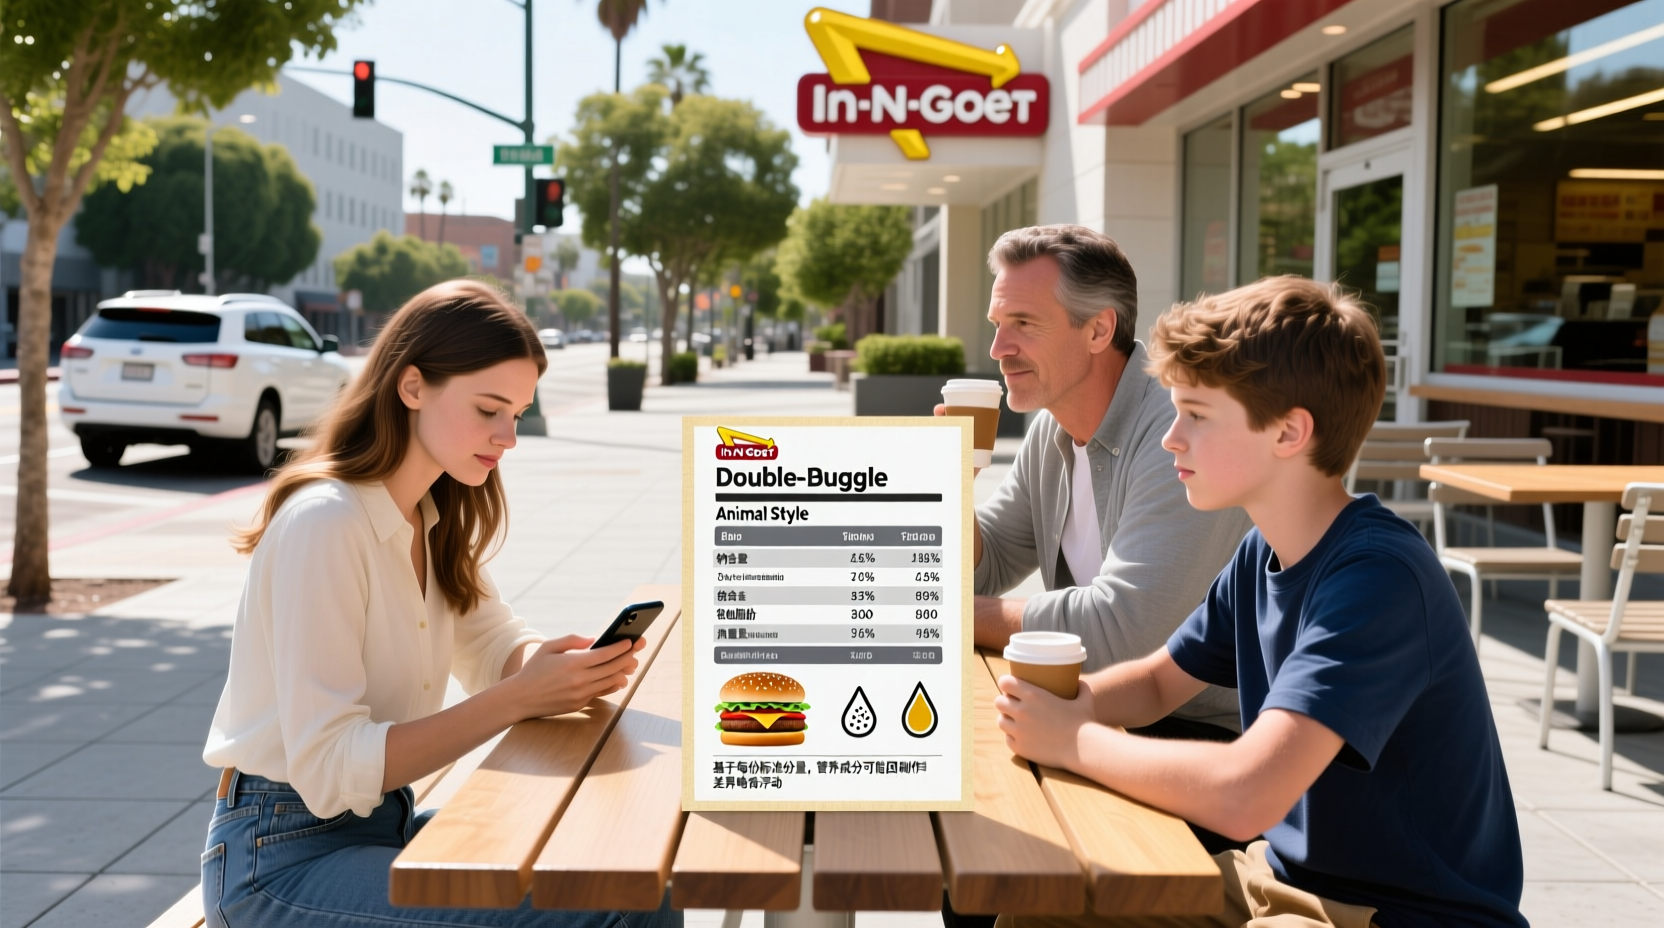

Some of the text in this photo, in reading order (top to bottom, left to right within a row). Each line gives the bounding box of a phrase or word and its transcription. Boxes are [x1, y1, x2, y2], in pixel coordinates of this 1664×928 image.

[716, 466, 888, 492] Double-Buggle
[716, 506, 809, 525] Animal Style
[850, 609, 874, 619] 300
